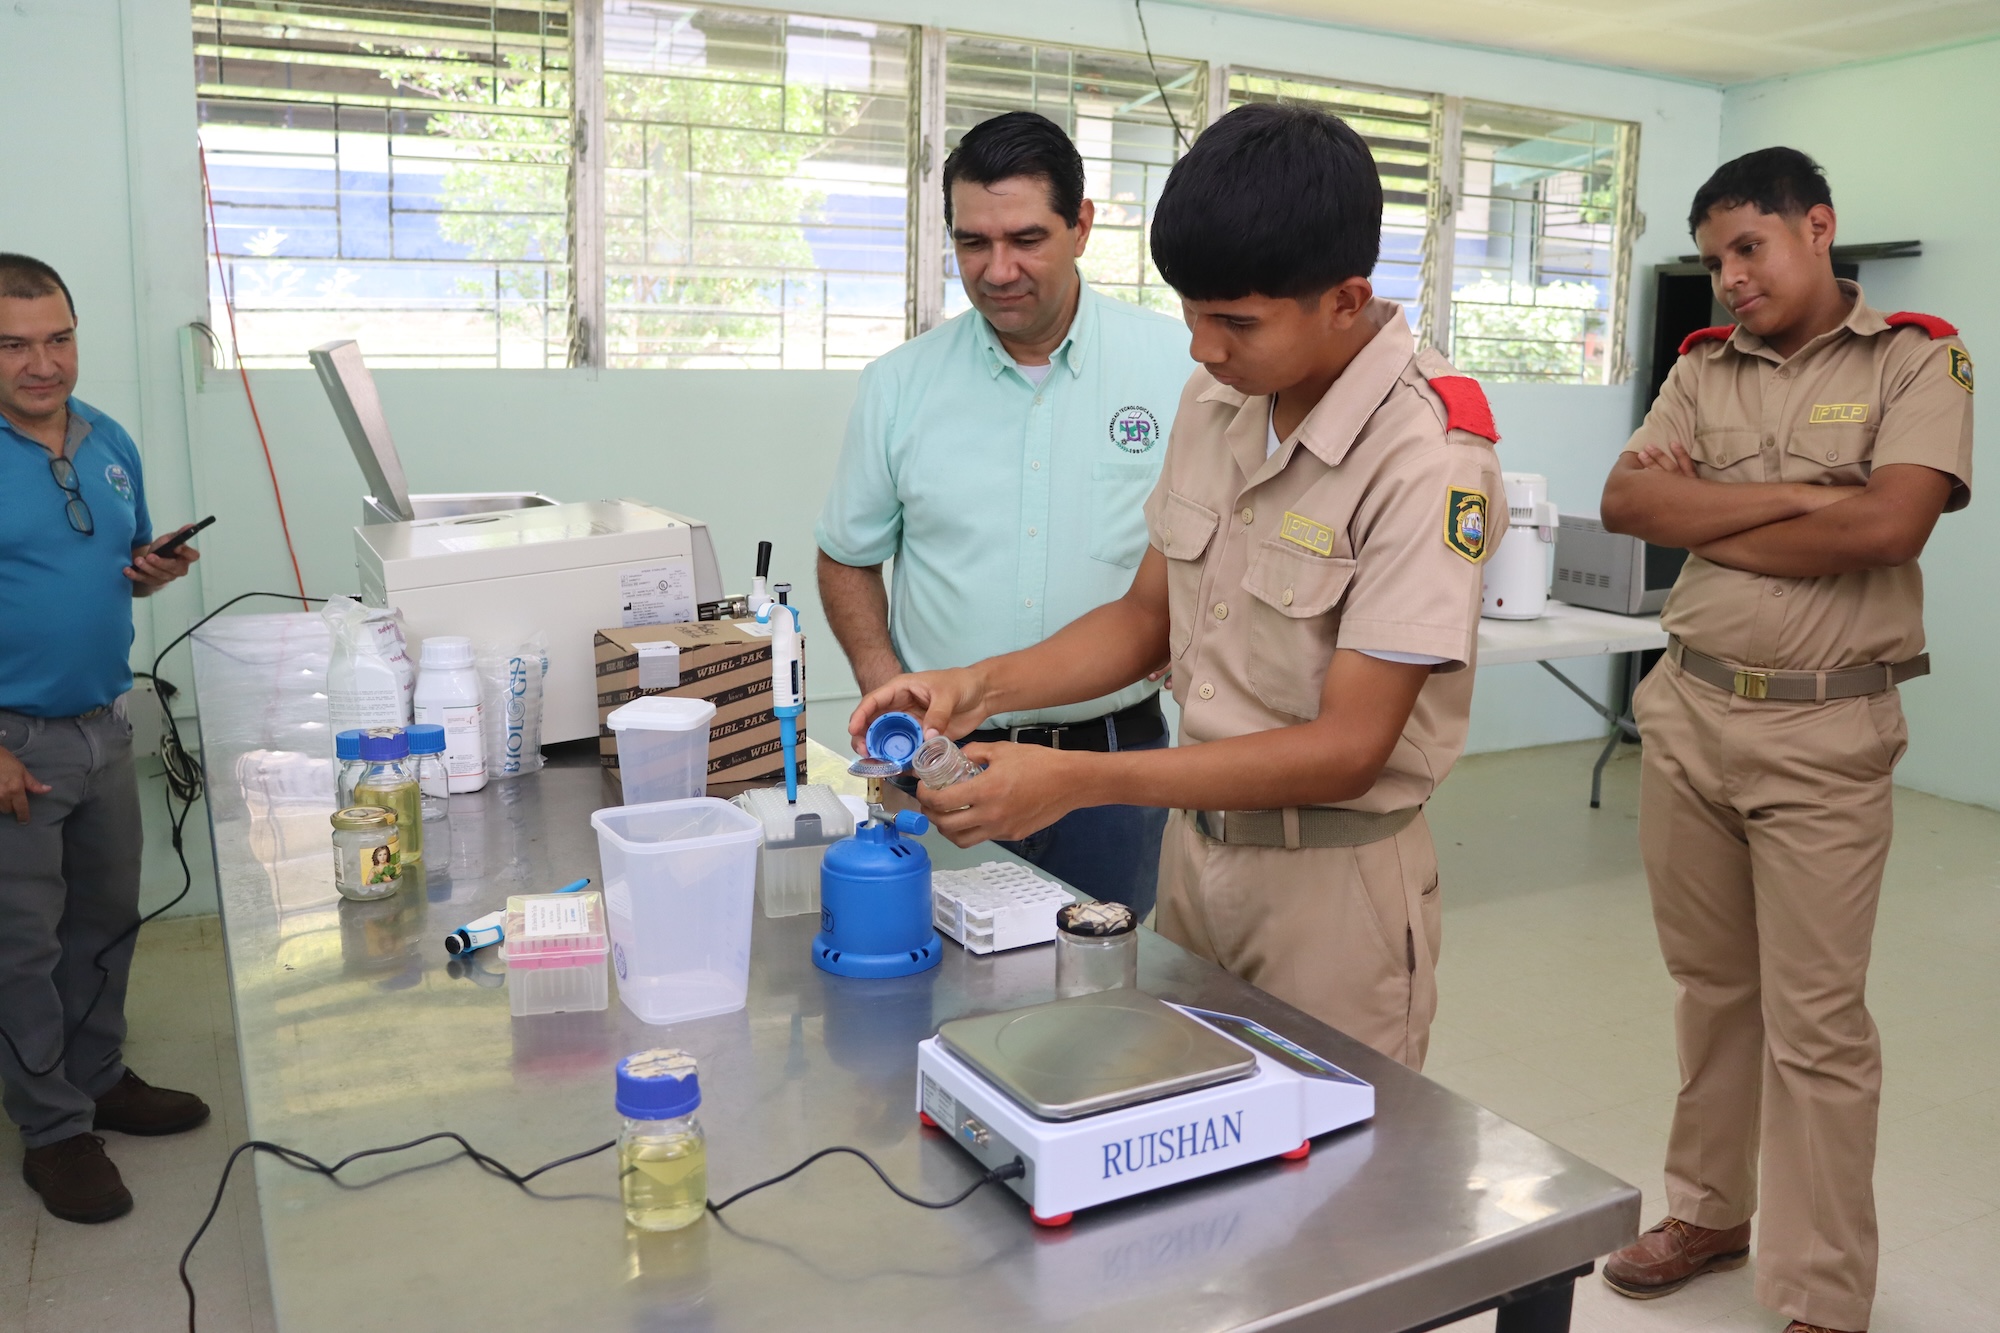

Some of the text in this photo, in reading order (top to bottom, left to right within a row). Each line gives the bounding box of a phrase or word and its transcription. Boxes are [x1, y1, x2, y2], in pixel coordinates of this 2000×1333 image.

[1816, 407, 1863, 420] IPTLP
[1285, 517, 1329, 546] IPTLP
[696, 650, 764, 679] WHIRL-PAK
[709, 713, 768, 739] HIRL-PAK
[1101, 1110, 1244, 1179] RUISHAN
